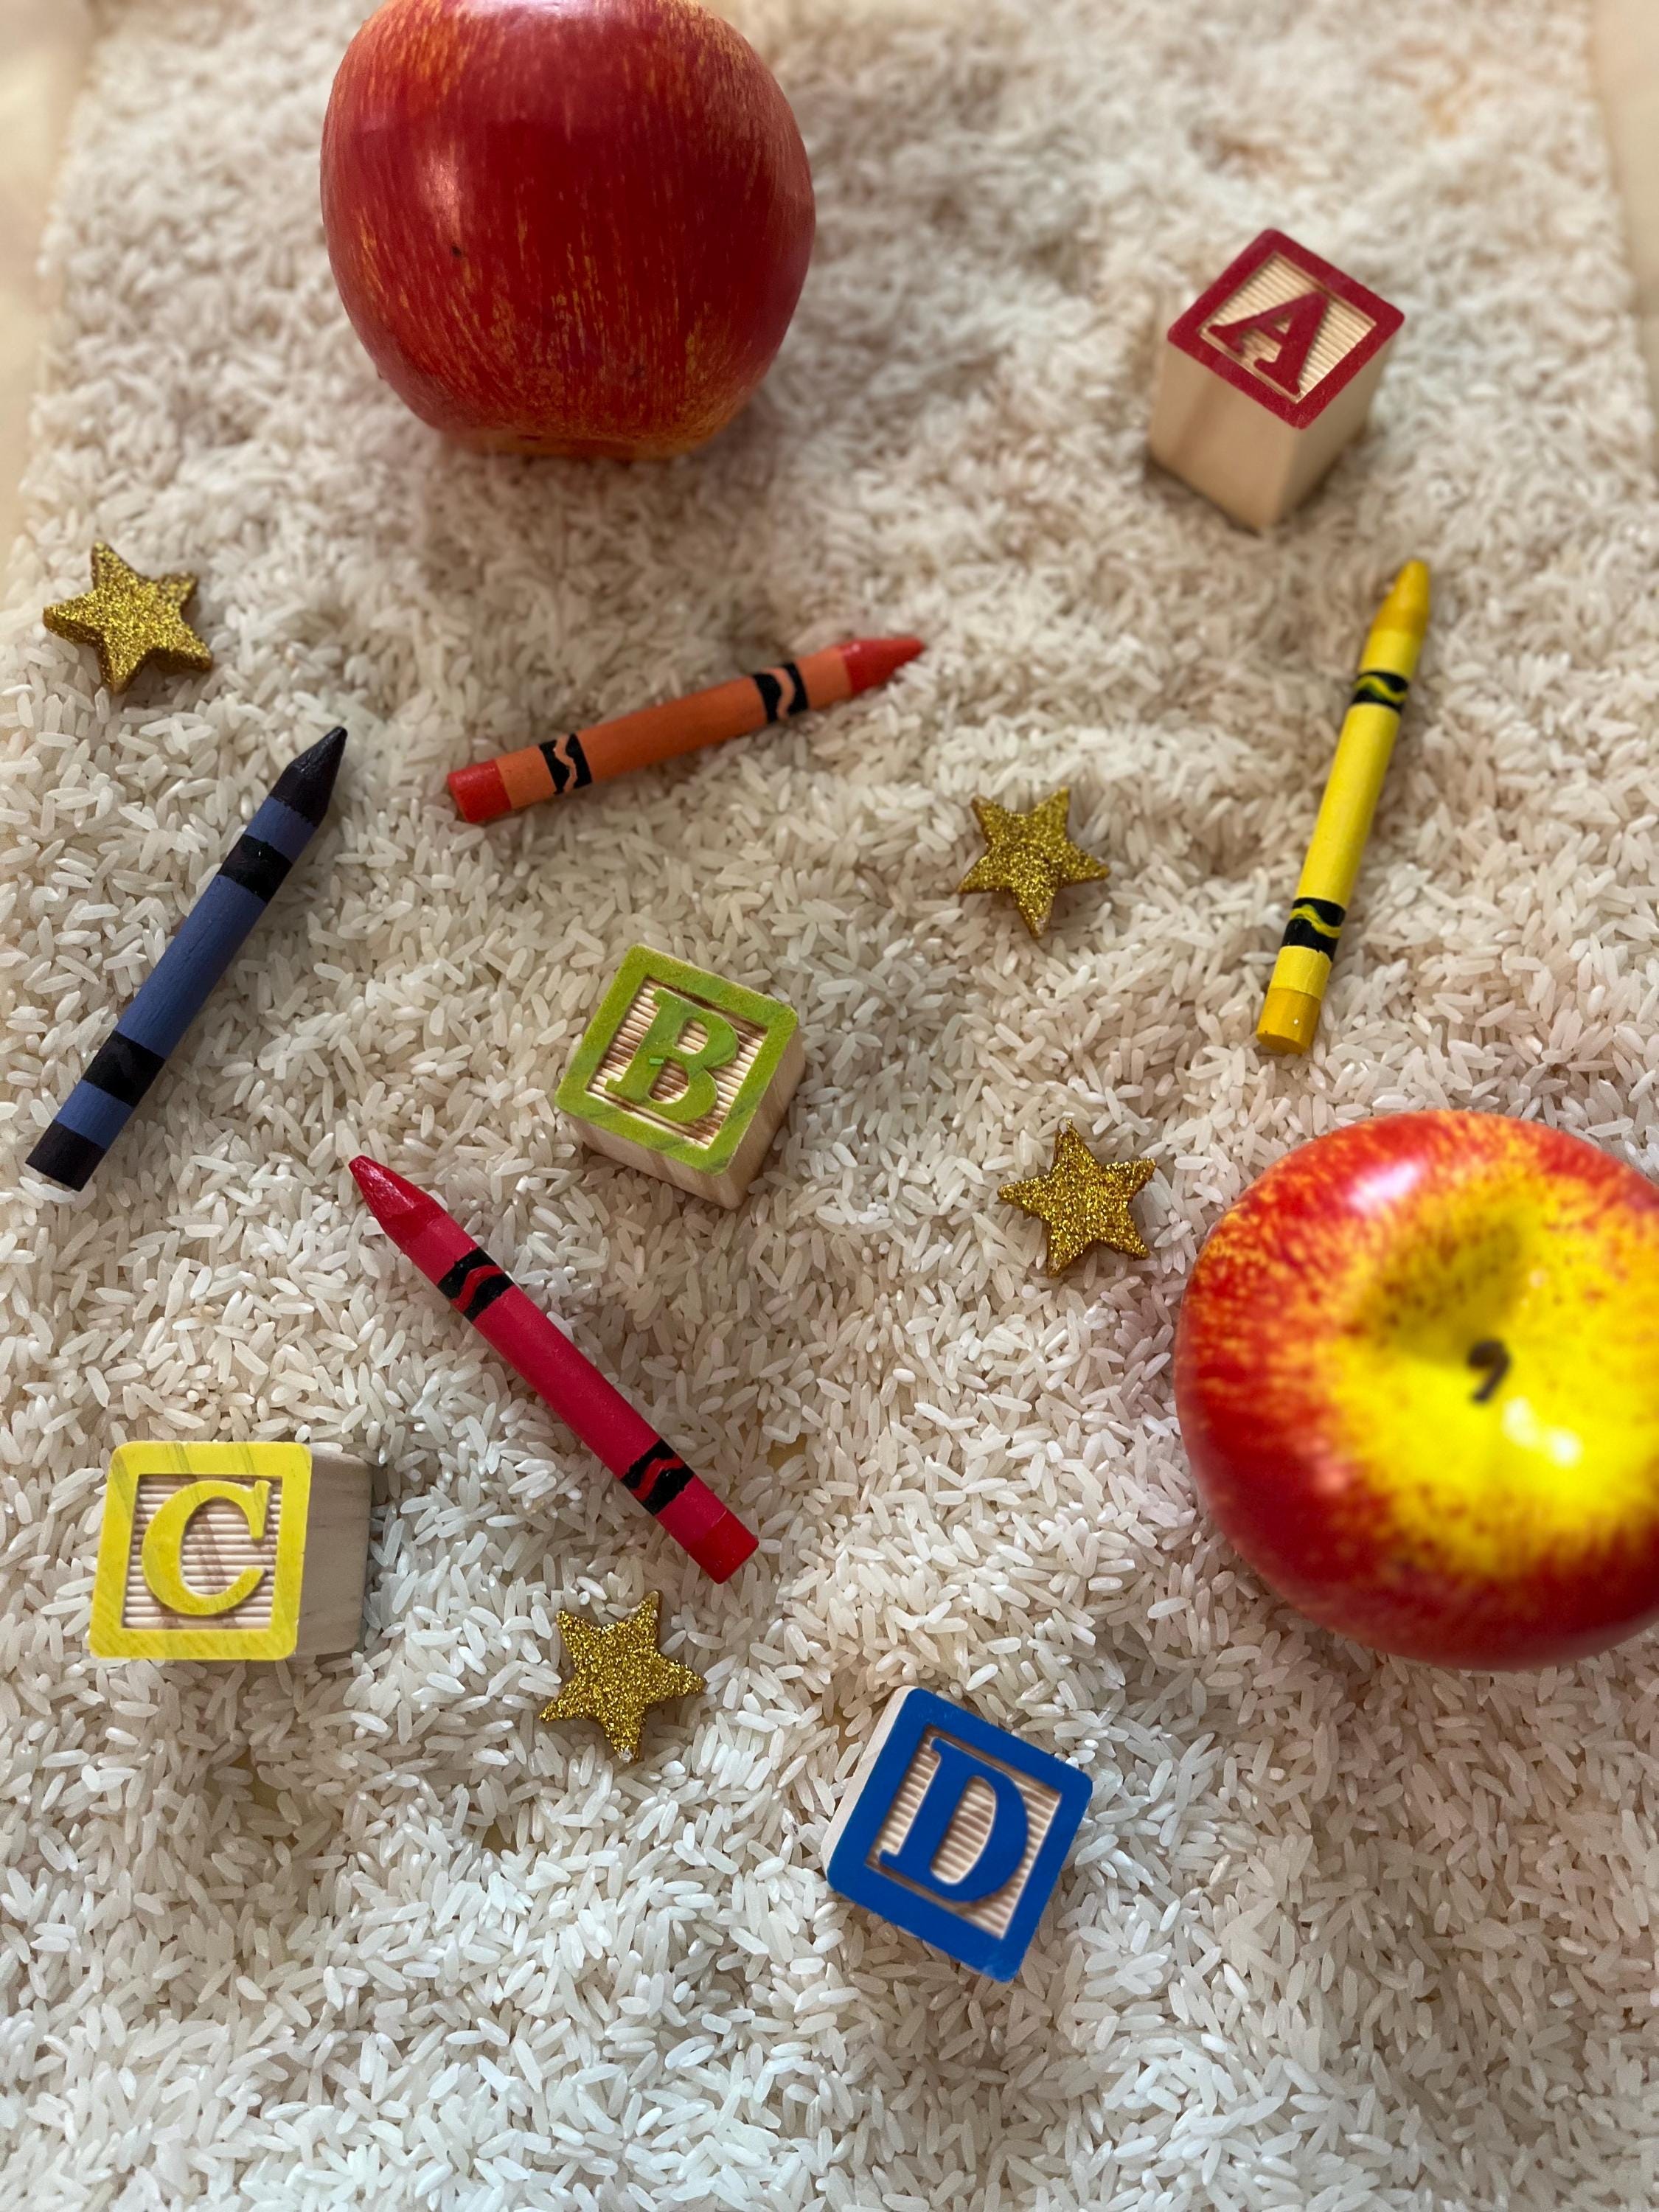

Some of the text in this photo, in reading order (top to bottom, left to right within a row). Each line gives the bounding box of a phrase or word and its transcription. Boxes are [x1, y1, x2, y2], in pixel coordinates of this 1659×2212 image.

[1208, 291, 1329, 397] A
[605, 988, 737, 1121] B
[142, 1480, 271, 1615] C
[879, 1736, 1029, 1903] D
